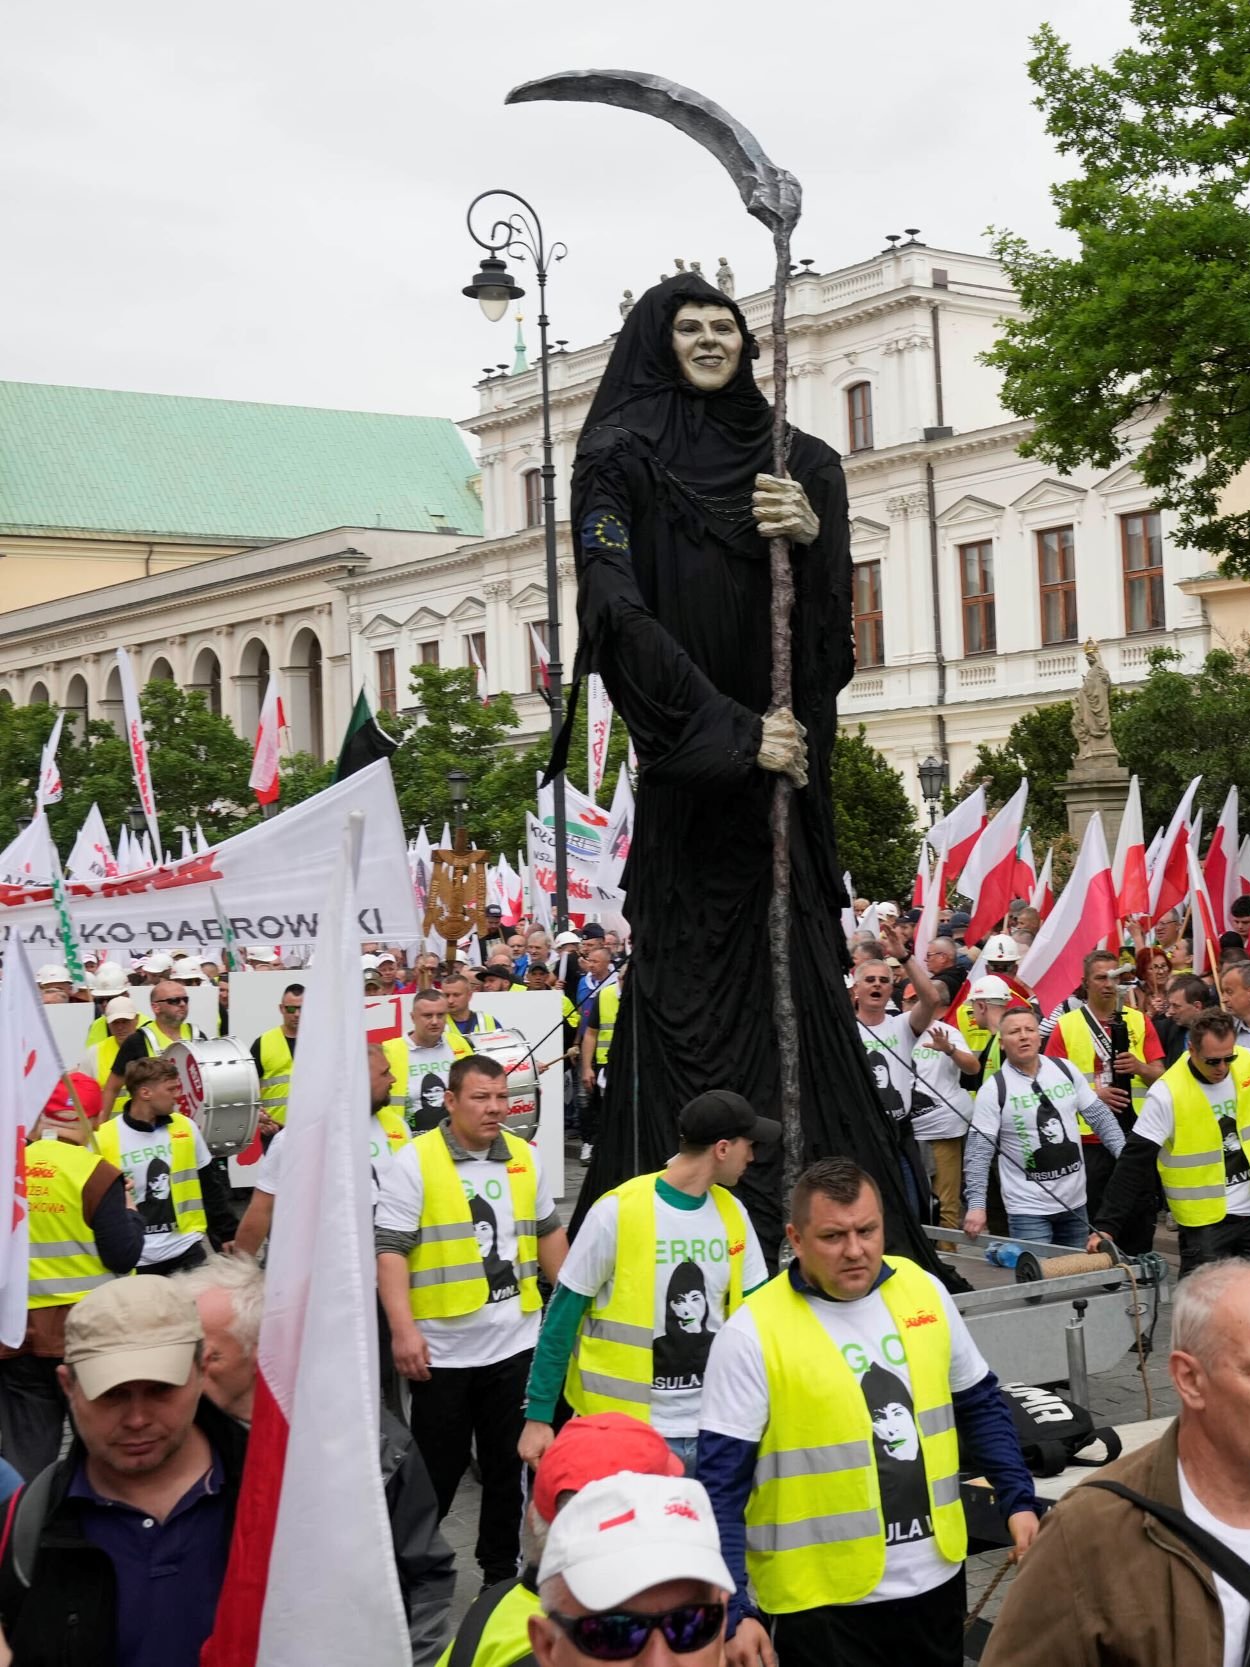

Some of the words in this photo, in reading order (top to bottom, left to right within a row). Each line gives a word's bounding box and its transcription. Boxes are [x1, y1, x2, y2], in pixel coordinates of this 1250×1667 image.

[461, 1179, 502, 1200] GO
[656, 1238, 729, 1263] ERRO
[841, 1334, 908, 1374] GO
[651, 1373, 702, 1389] SULA
[1000, 1381, 1074, 1424] UMA
